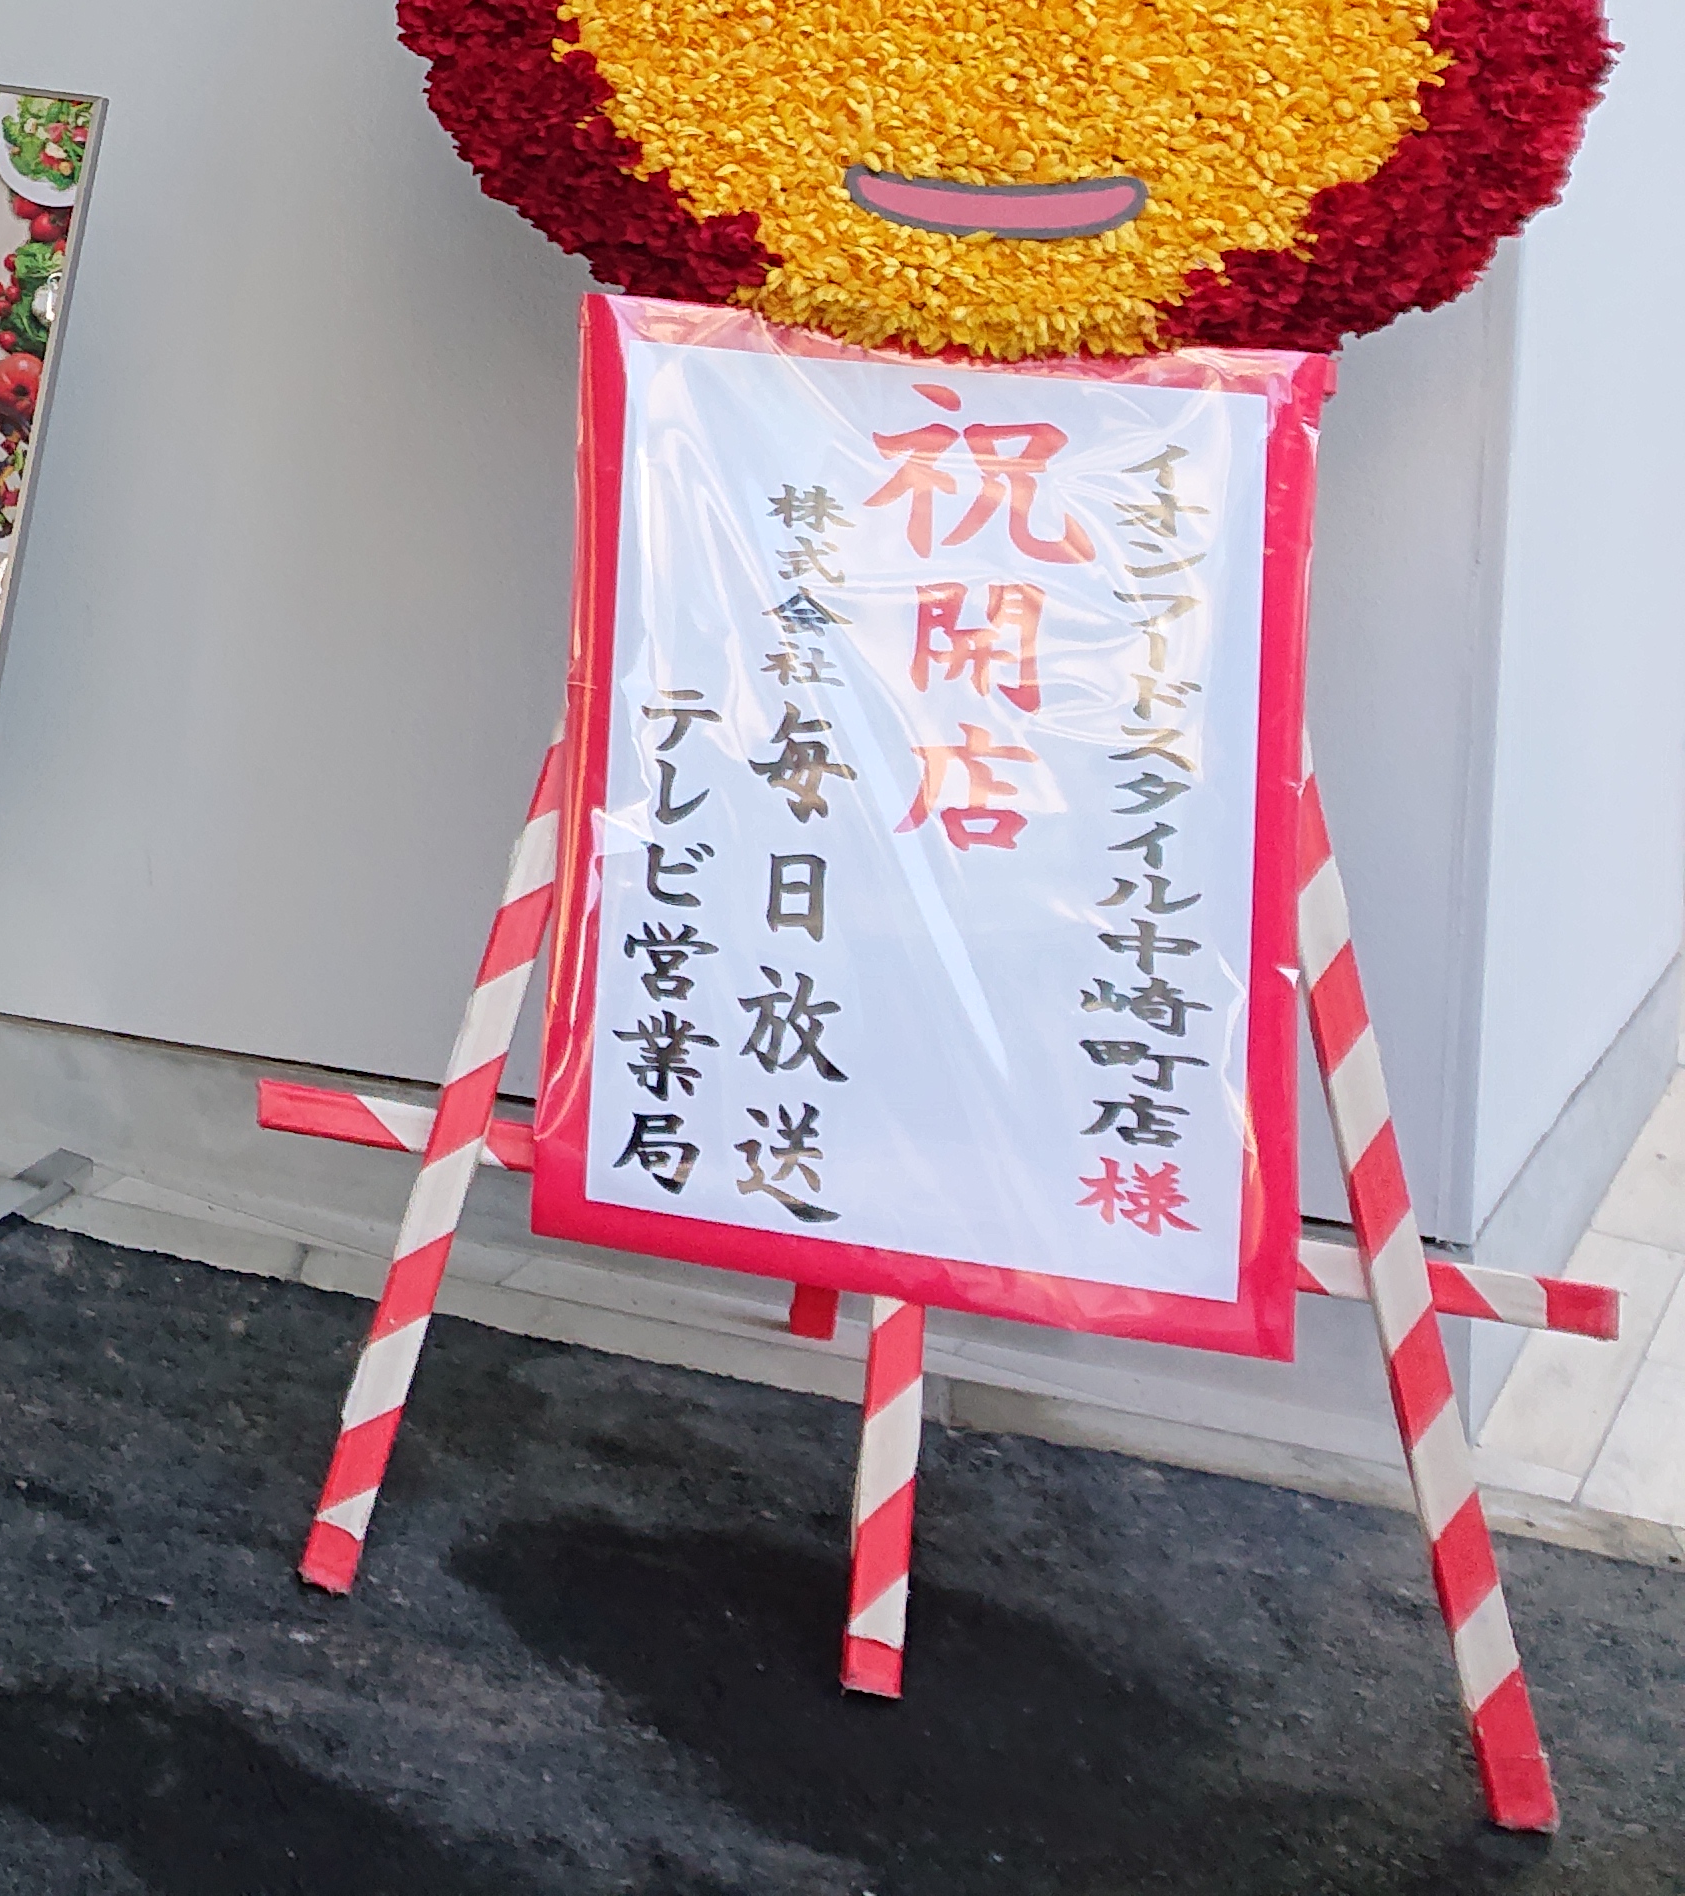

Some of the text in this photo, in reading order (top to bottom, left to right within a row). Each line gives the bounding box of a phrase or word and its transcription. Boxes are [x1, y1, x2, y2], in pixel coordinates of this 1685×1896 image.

[735, 483, 859, 1225] 株式会社毎日放送
[864, 382, 1099, 854] 祝開店
[1076, 442, 1212, 1238] イオンフードスタイル中崎町店様
[612, 687, 724, 1195] テレビ営業局
